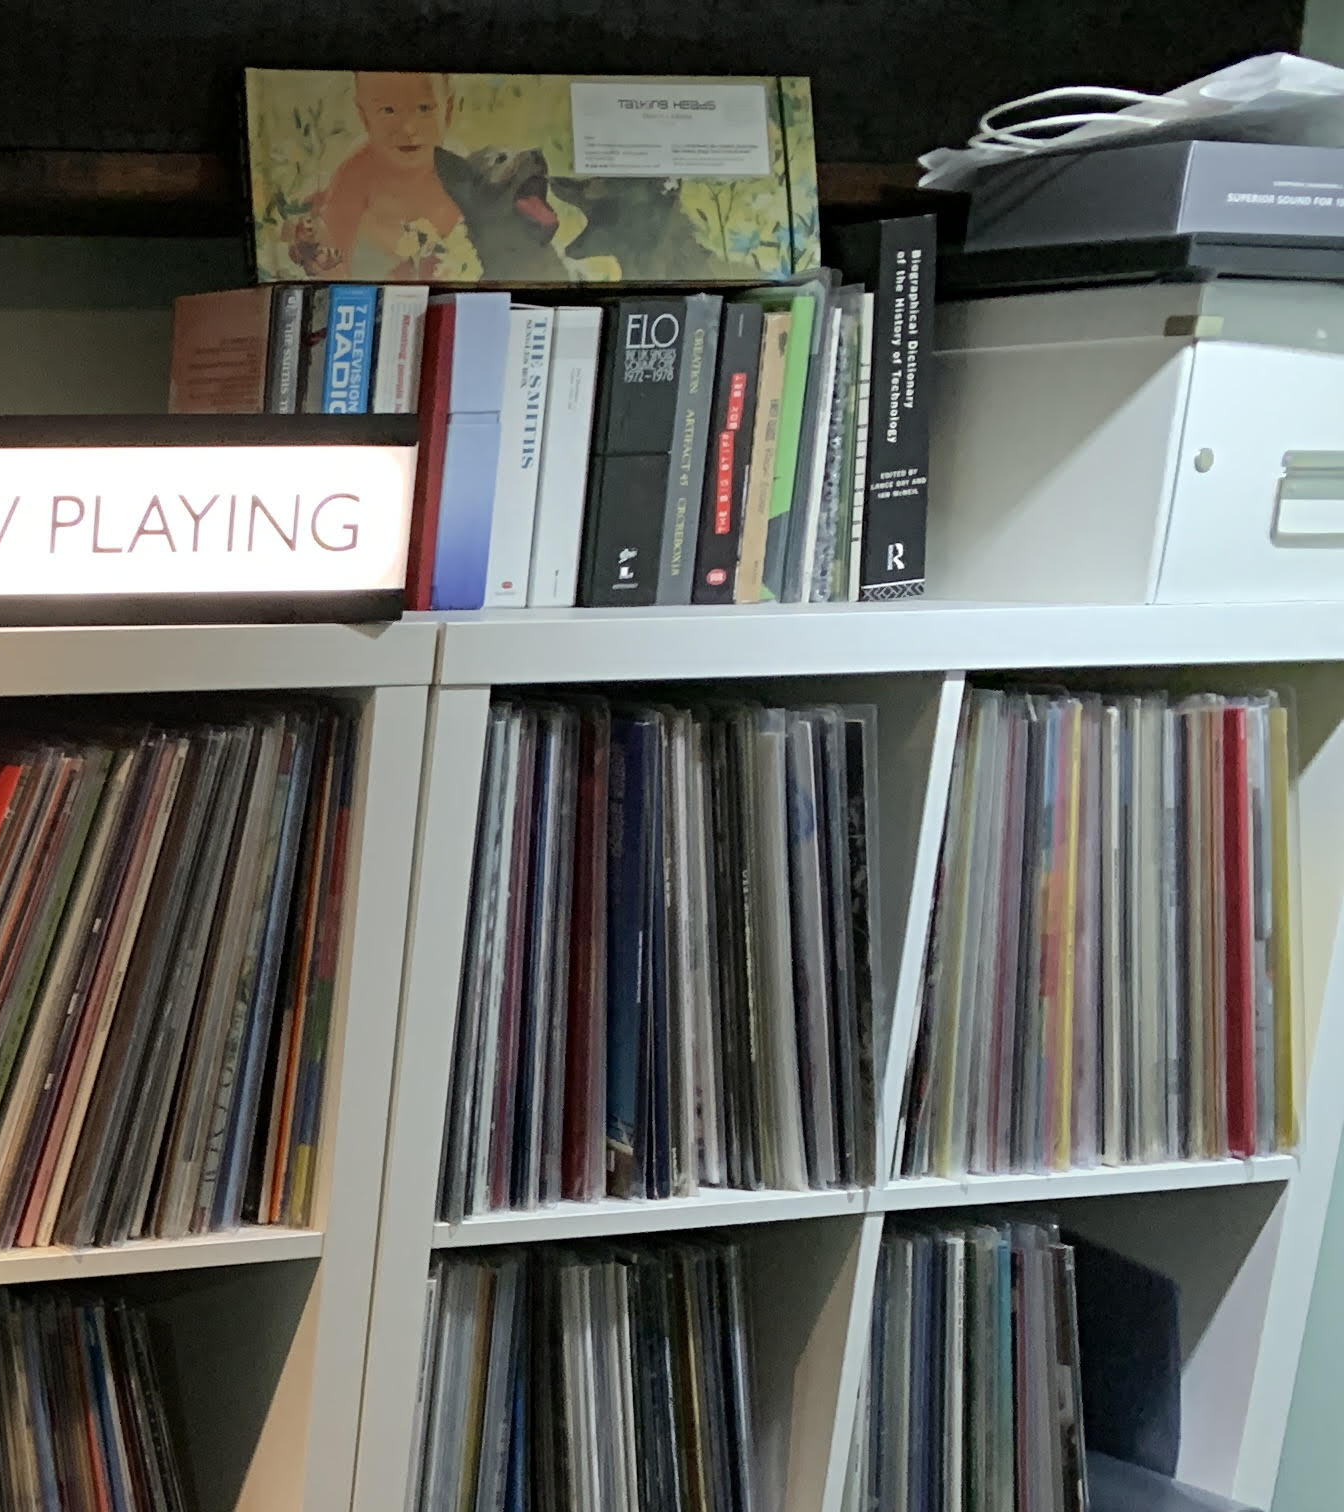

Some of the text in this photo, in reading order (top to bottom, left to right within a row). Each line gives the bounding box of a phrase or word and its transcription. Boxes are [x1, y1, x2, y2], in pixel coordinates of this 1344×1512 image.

[626, 313, 679, 349] ELO
[687, 327, 704, 394] CREATION
[885, 249, 907, 444] of the History of Technology
[902, 248, 922, 408] Biographical Dictionary
[519, 315, 548, 470] THE SMITHS
[679, 407, 696, 471] ARTIFACT
[49, 493, 360, 553] PLAYING
[887, 542, 905, 571] R
